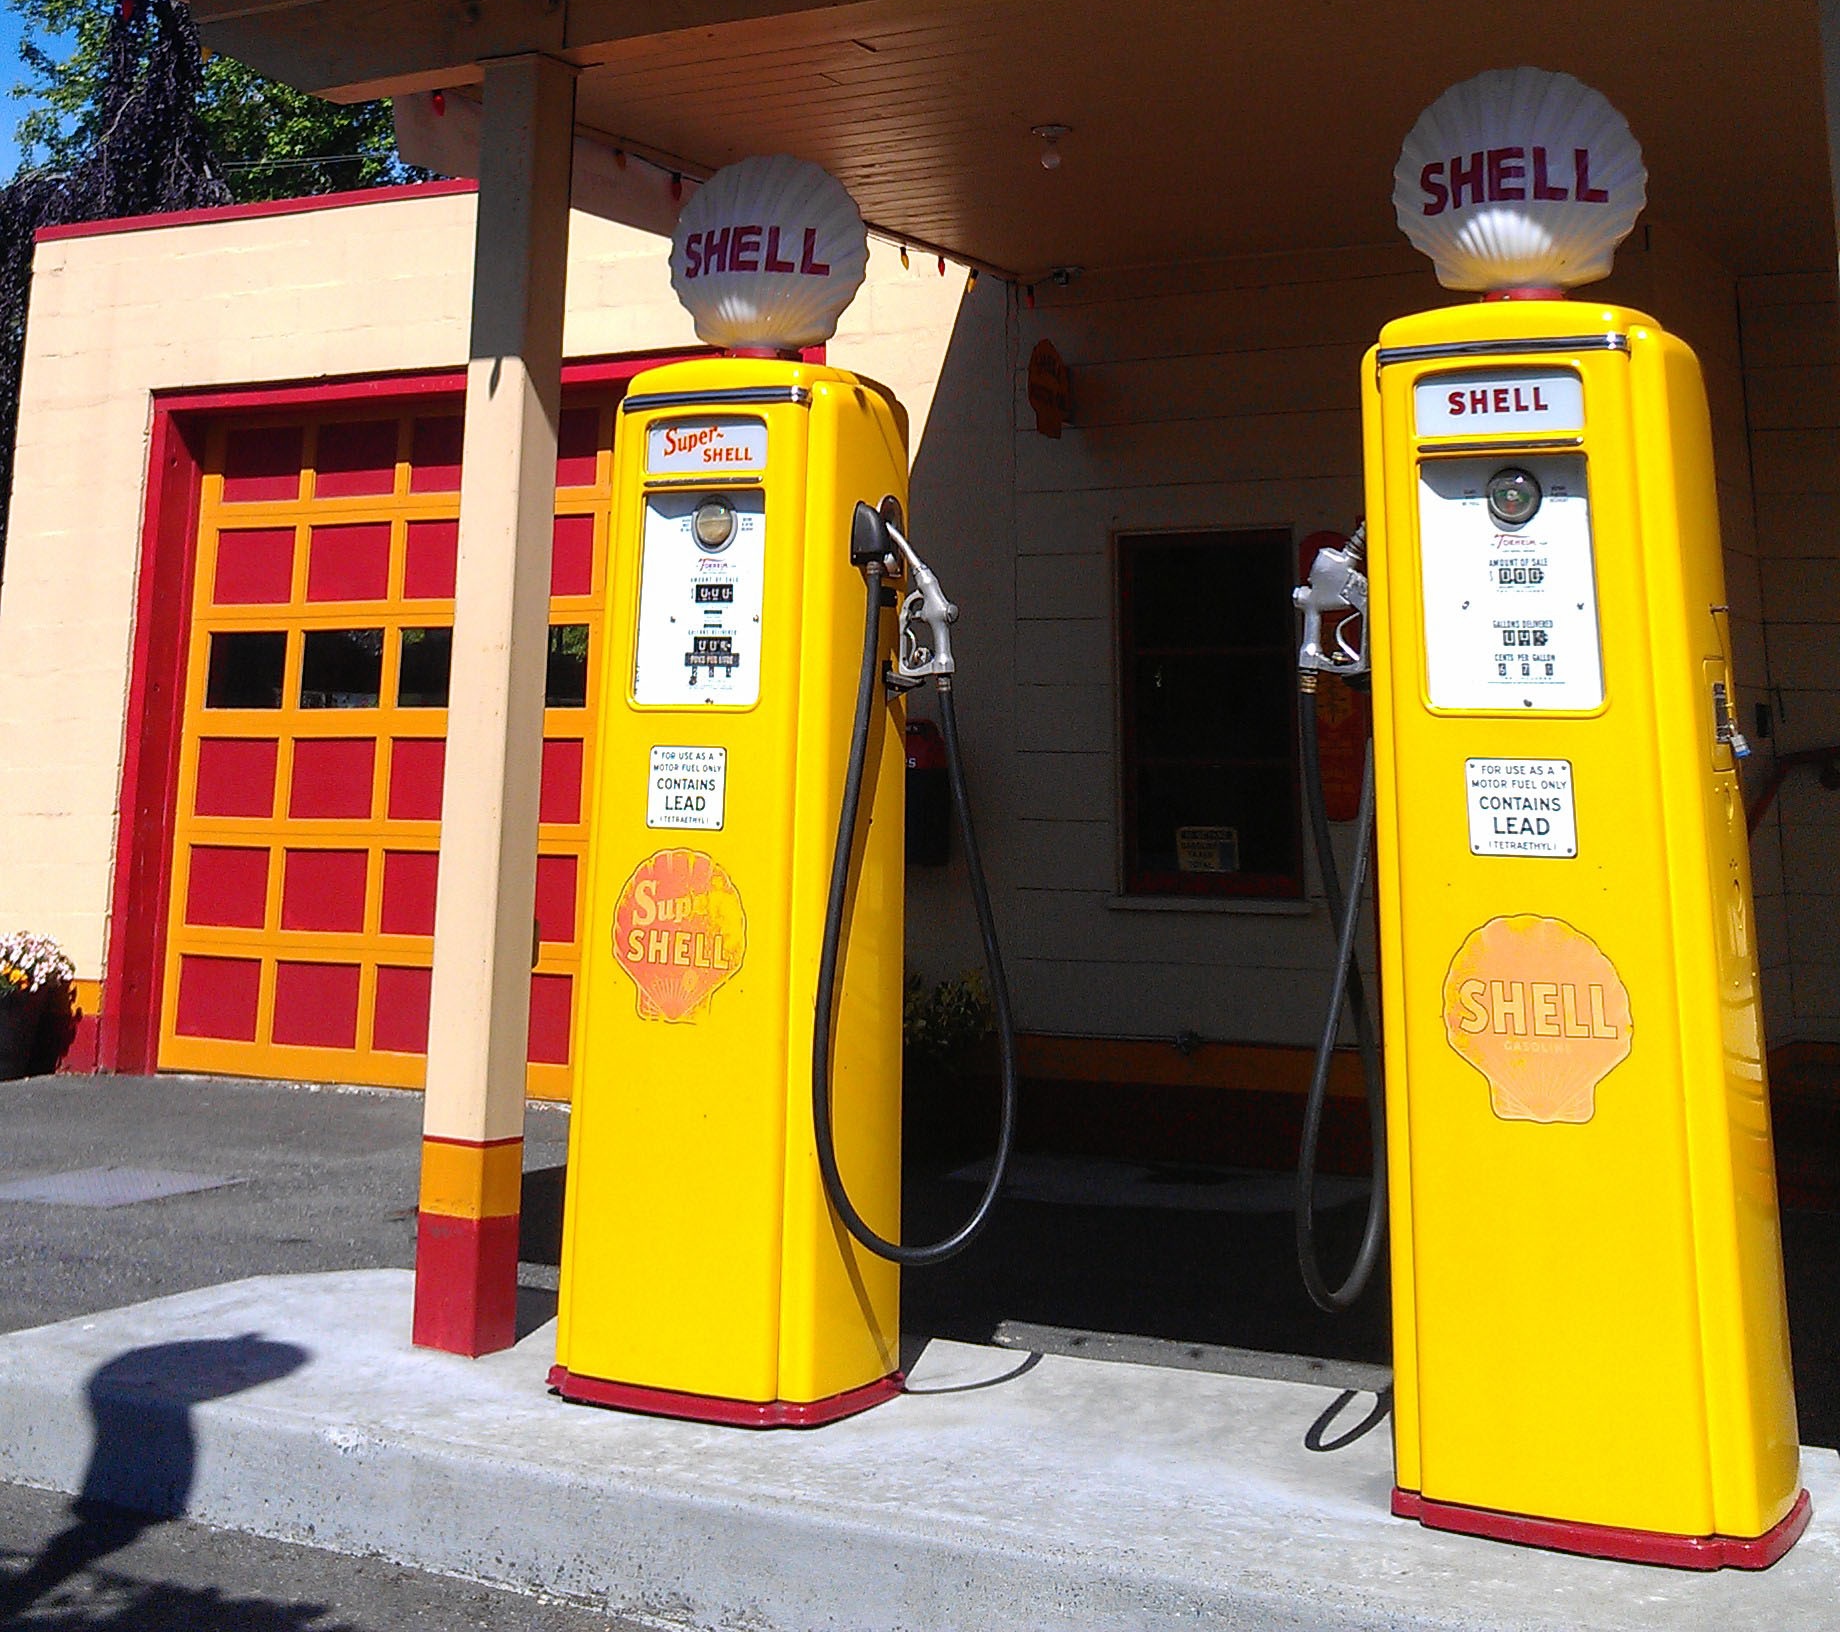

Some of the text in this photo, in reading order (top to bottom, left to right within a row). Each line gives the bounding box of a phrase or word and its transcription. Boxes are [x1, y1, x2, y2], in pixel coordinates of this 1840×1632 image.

[1420, 146, 1609, 216] SHELL
[685, 225, 830, 279] SHELL
[1448, 386, 1549, 415] SHELL
[703, 446, 753, 462] SHELL
[662, 752, 676, 760] FOR
[679, 752, 693, 760] USE
[695, 752, 706, 760] AS
[653, 763, 722, 772] MOTOR FUEL ONLY
[1481, 765, 1555, 775] FOR USE AS A
[657, 777, 716, 791] CONTAINS
[1472, 779, 1567, 790] MOTOR FUEL ONLY
[665, 795, 706, 811] LEAD
[1479, 796, 1561, 811] CONTAINS
[1493, 816, 1550, 835] LEAD
[626, 928, 729, 971] SHELL
[1458, 978, 1619, 1039] SHELL
